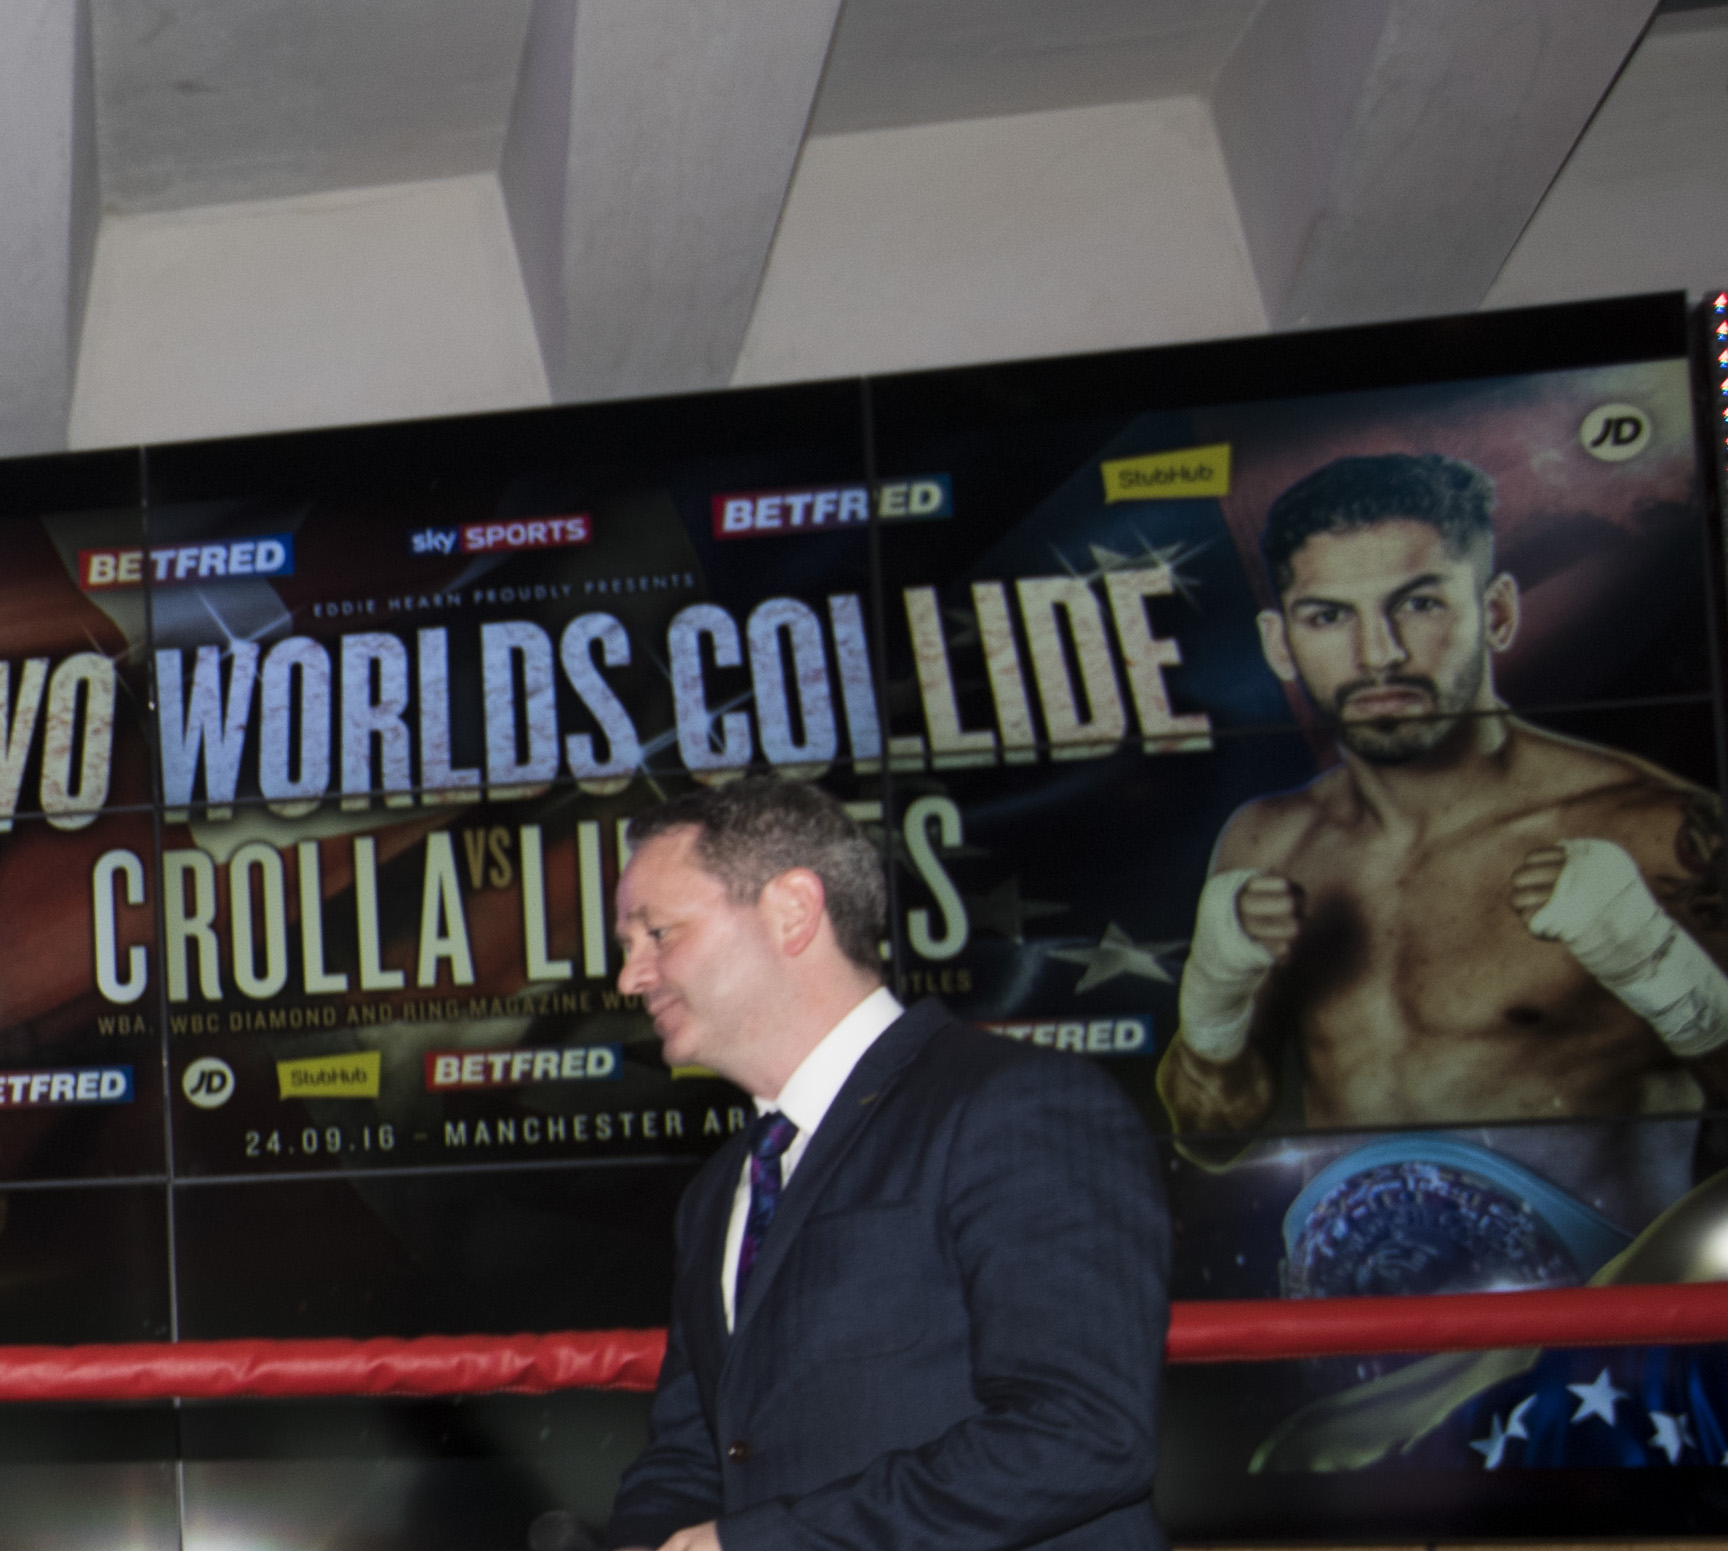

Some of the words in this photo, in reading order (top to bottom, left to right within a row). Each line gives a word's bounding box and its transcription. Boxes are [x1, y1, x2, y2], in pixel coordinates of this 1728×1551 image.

[1591, 416, 1643, 448] JD
[1118, 463, 1213, 490] StubHub
[723, 481, 944, 531] BETFRED
[411, 529, 456, 554] sky
[464, 516, 585, 550] SPORTS
[87, 541, 286, 584] BETFRED
[313, 599, 376, 619] EDDIE
[388, 592, 462, 612] HEARN
[472, 582, 573, 606] PROUDLY
[584, 571, 694, 595] PRESENTS
[155, 611, 640, 826] WORLDS
[667, 565, 1213, 786] COLLIDE
[92, 830, 475, 1004] CROLLA
[464, 826, 513, 888] VS
[170, 1012, 220, 1036] WBC
[229, 1004, 337, 1033] DIAMOND
[346, 1000, 392, 1027] AND
[469, 991, 592, 1017] MAGAZINE
[189, 1069, 227, 1096] JD
[433, 1047, 615, 1084] BETFRED
[245, 1124, 395, 1158] 24.09.16
[444, 1108, 683, 1147] MANCHESTER
[702, 1106, 746, 1136] AR
